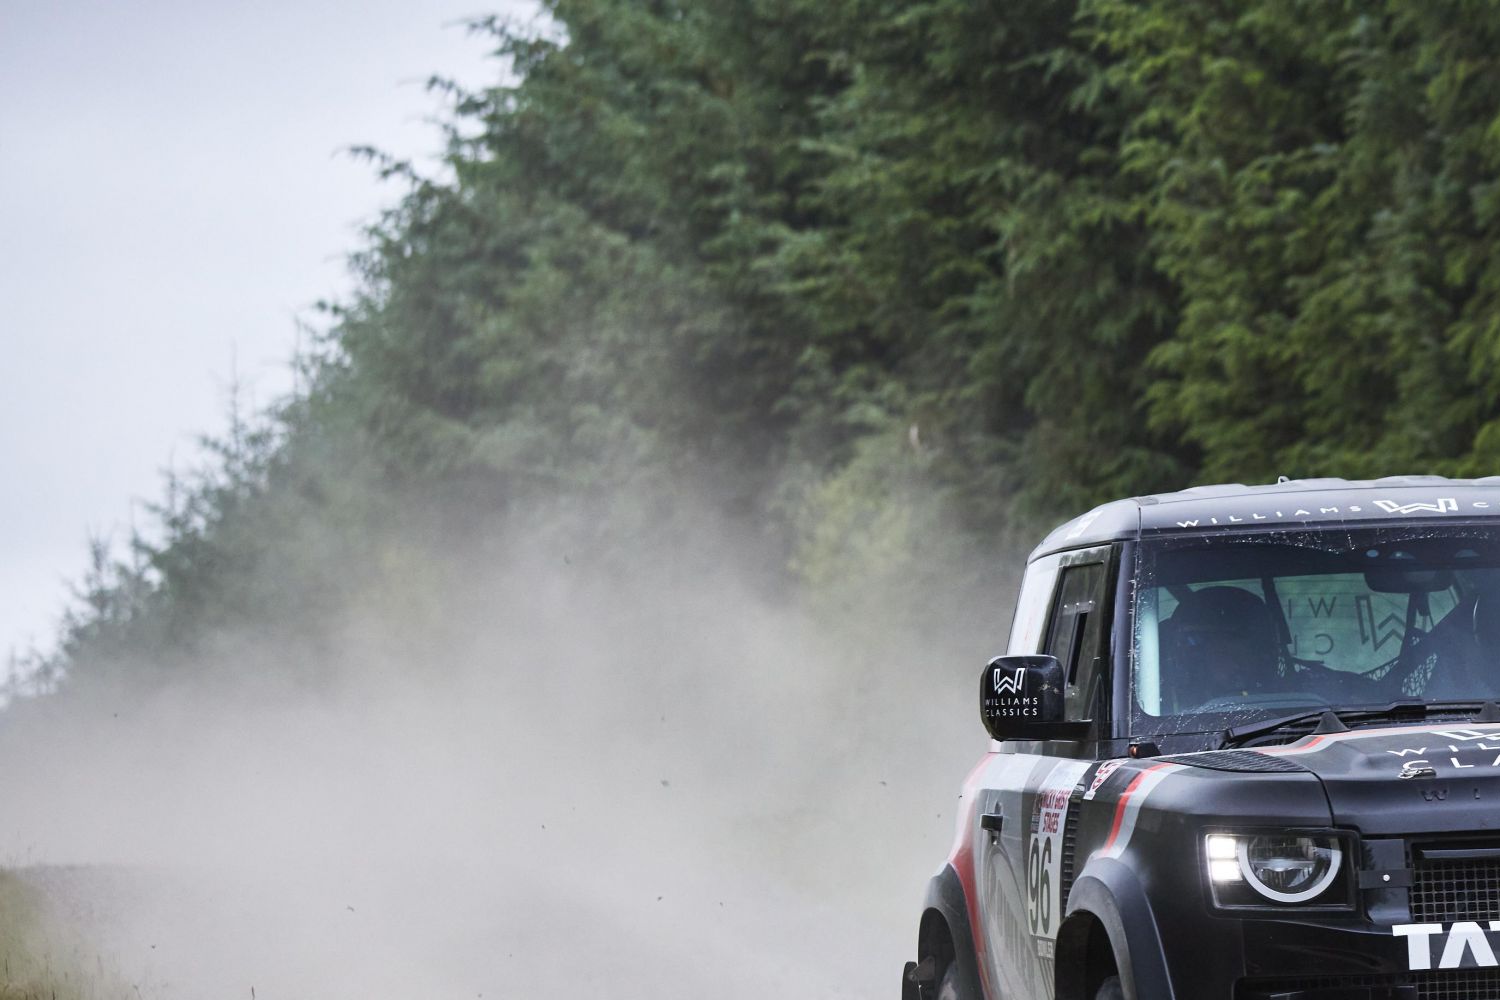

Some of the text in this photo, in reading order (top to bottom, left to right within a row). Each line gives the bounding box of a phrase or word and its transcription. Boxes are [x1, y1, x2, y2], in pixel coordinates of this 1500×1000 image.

[1177, 504, 1362, 529] WILLIAMS
[985, 697, 1038, 706] WILLIAMS
[985, 708, 1038, 717] CLASSICS
[1029, 836, 1052, 935] 96
